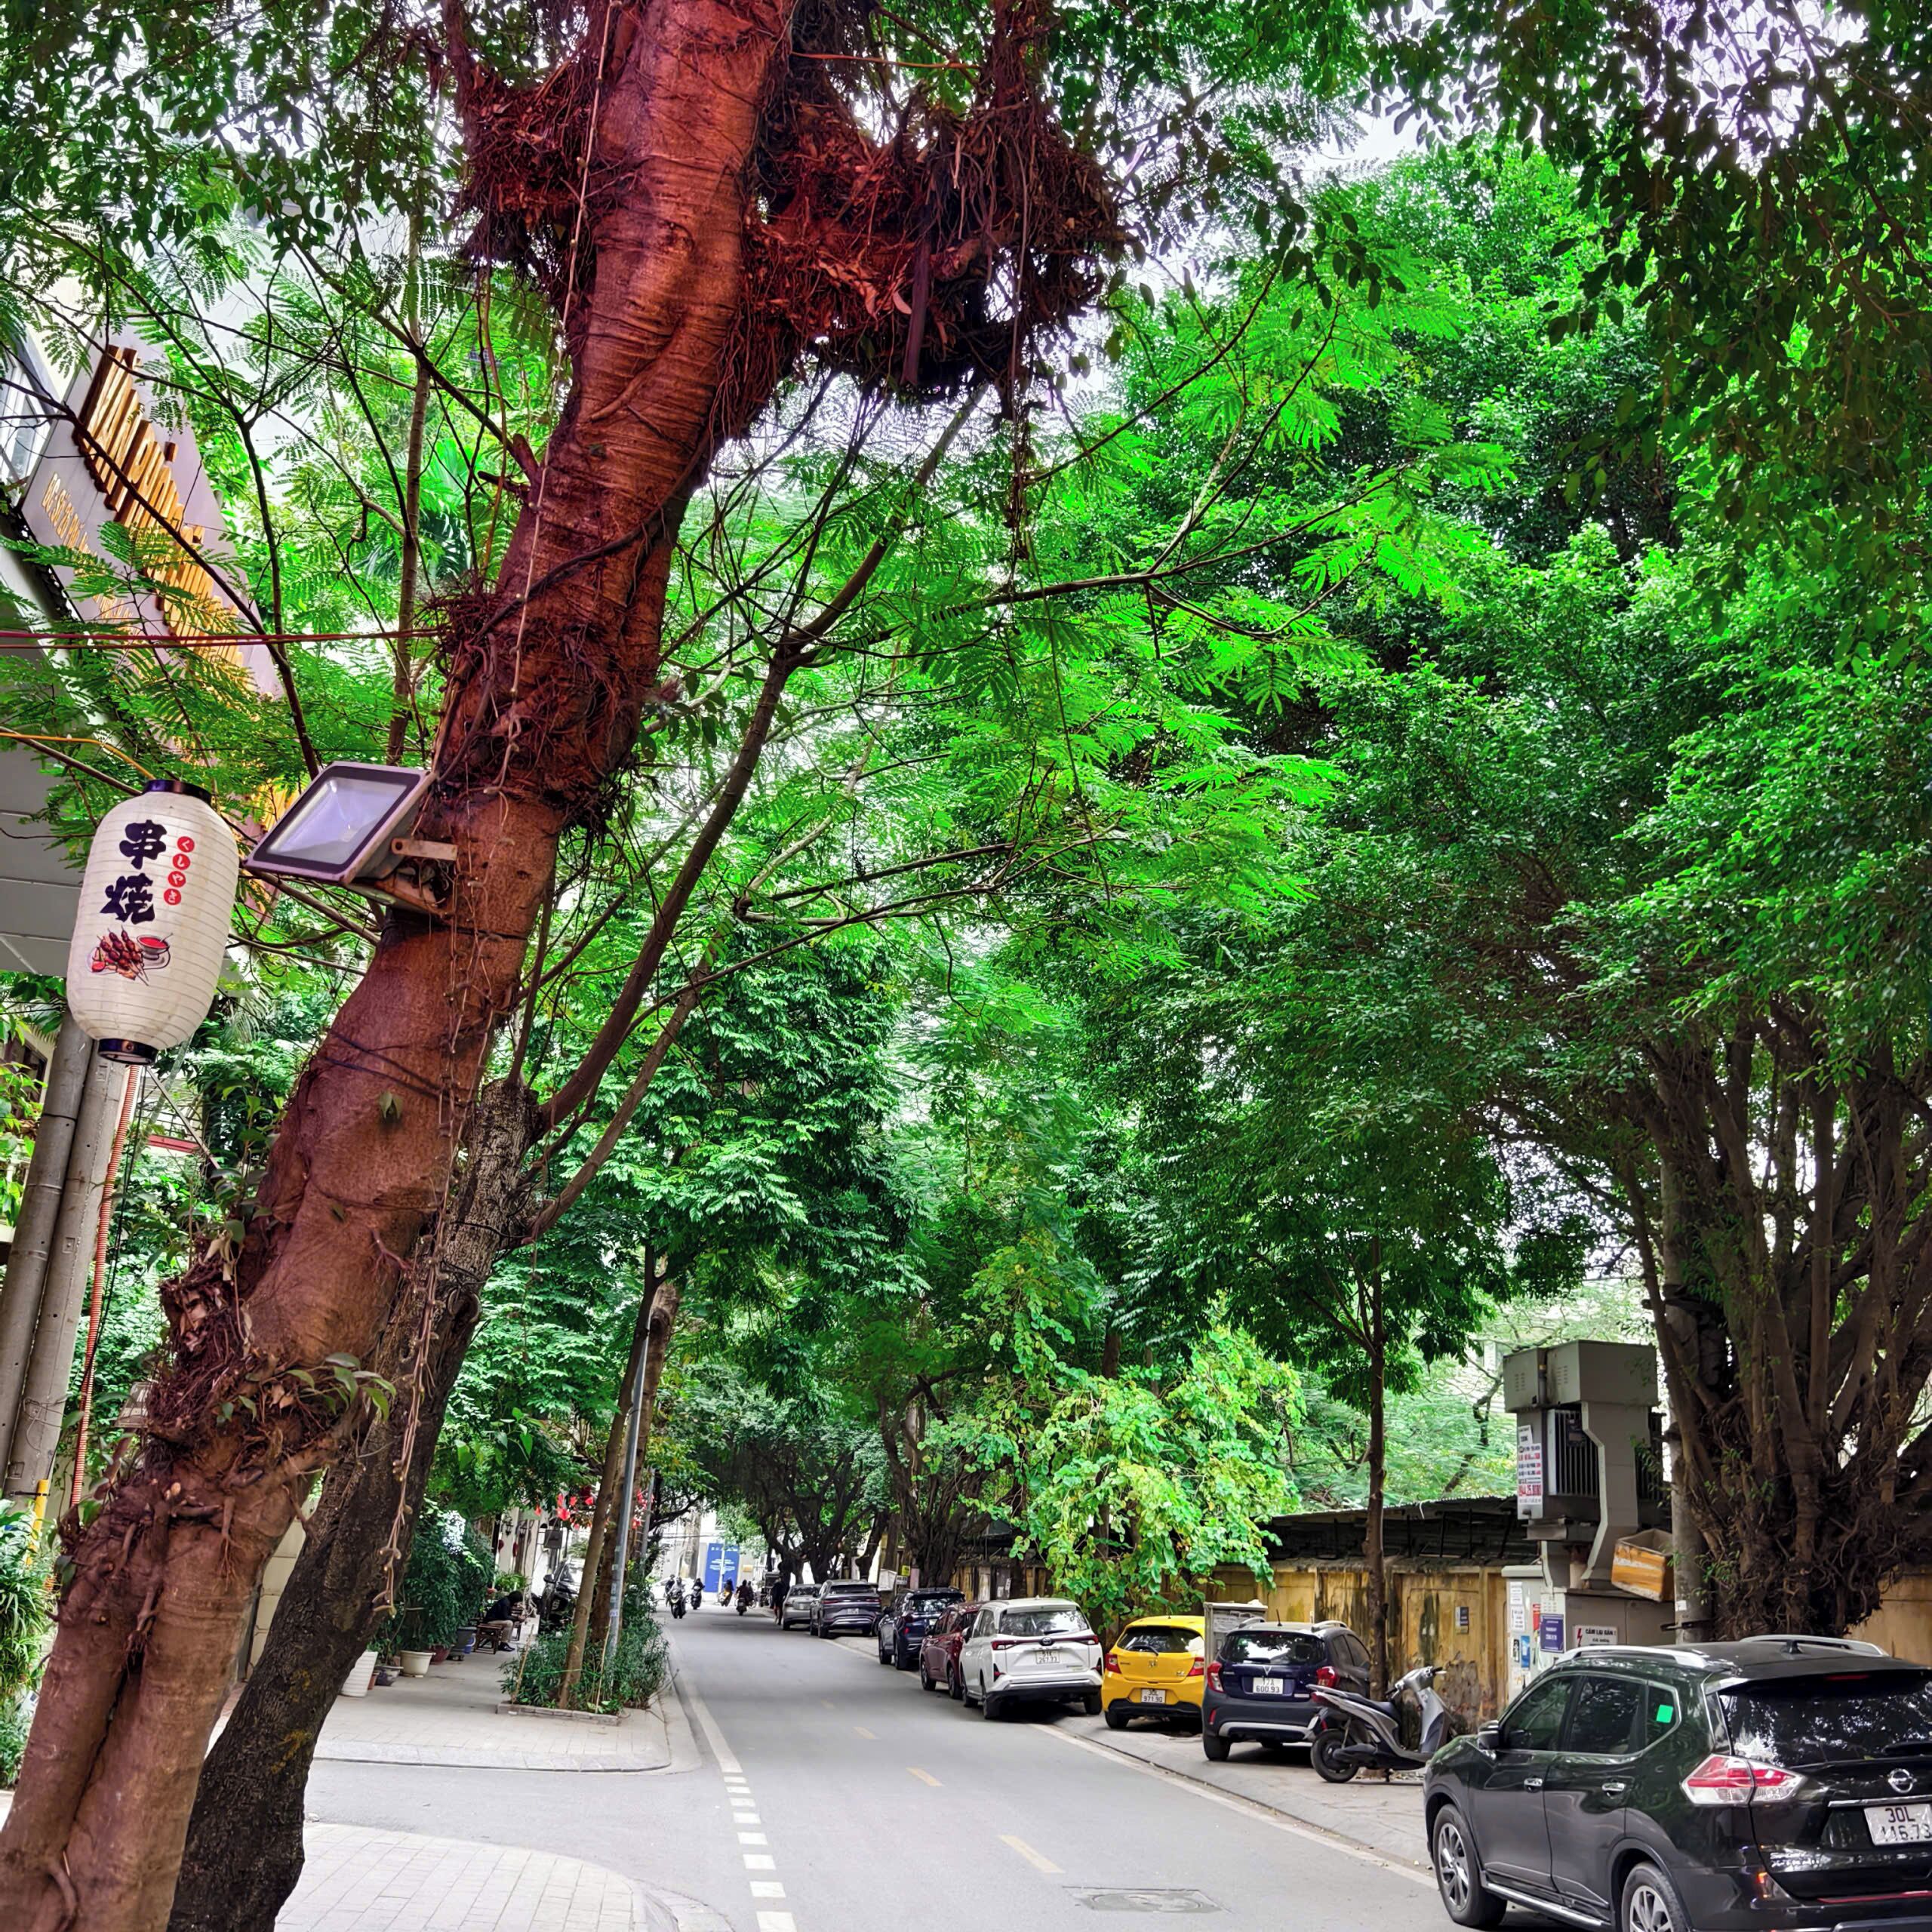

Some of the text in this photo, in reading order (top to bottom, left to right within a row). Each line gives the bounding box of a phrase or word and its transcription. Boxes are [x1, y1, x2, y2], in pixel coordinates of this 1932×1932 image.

[165, 838, 193, 904] くしやき
[1885, 1806, 1916, 1823] 30L
